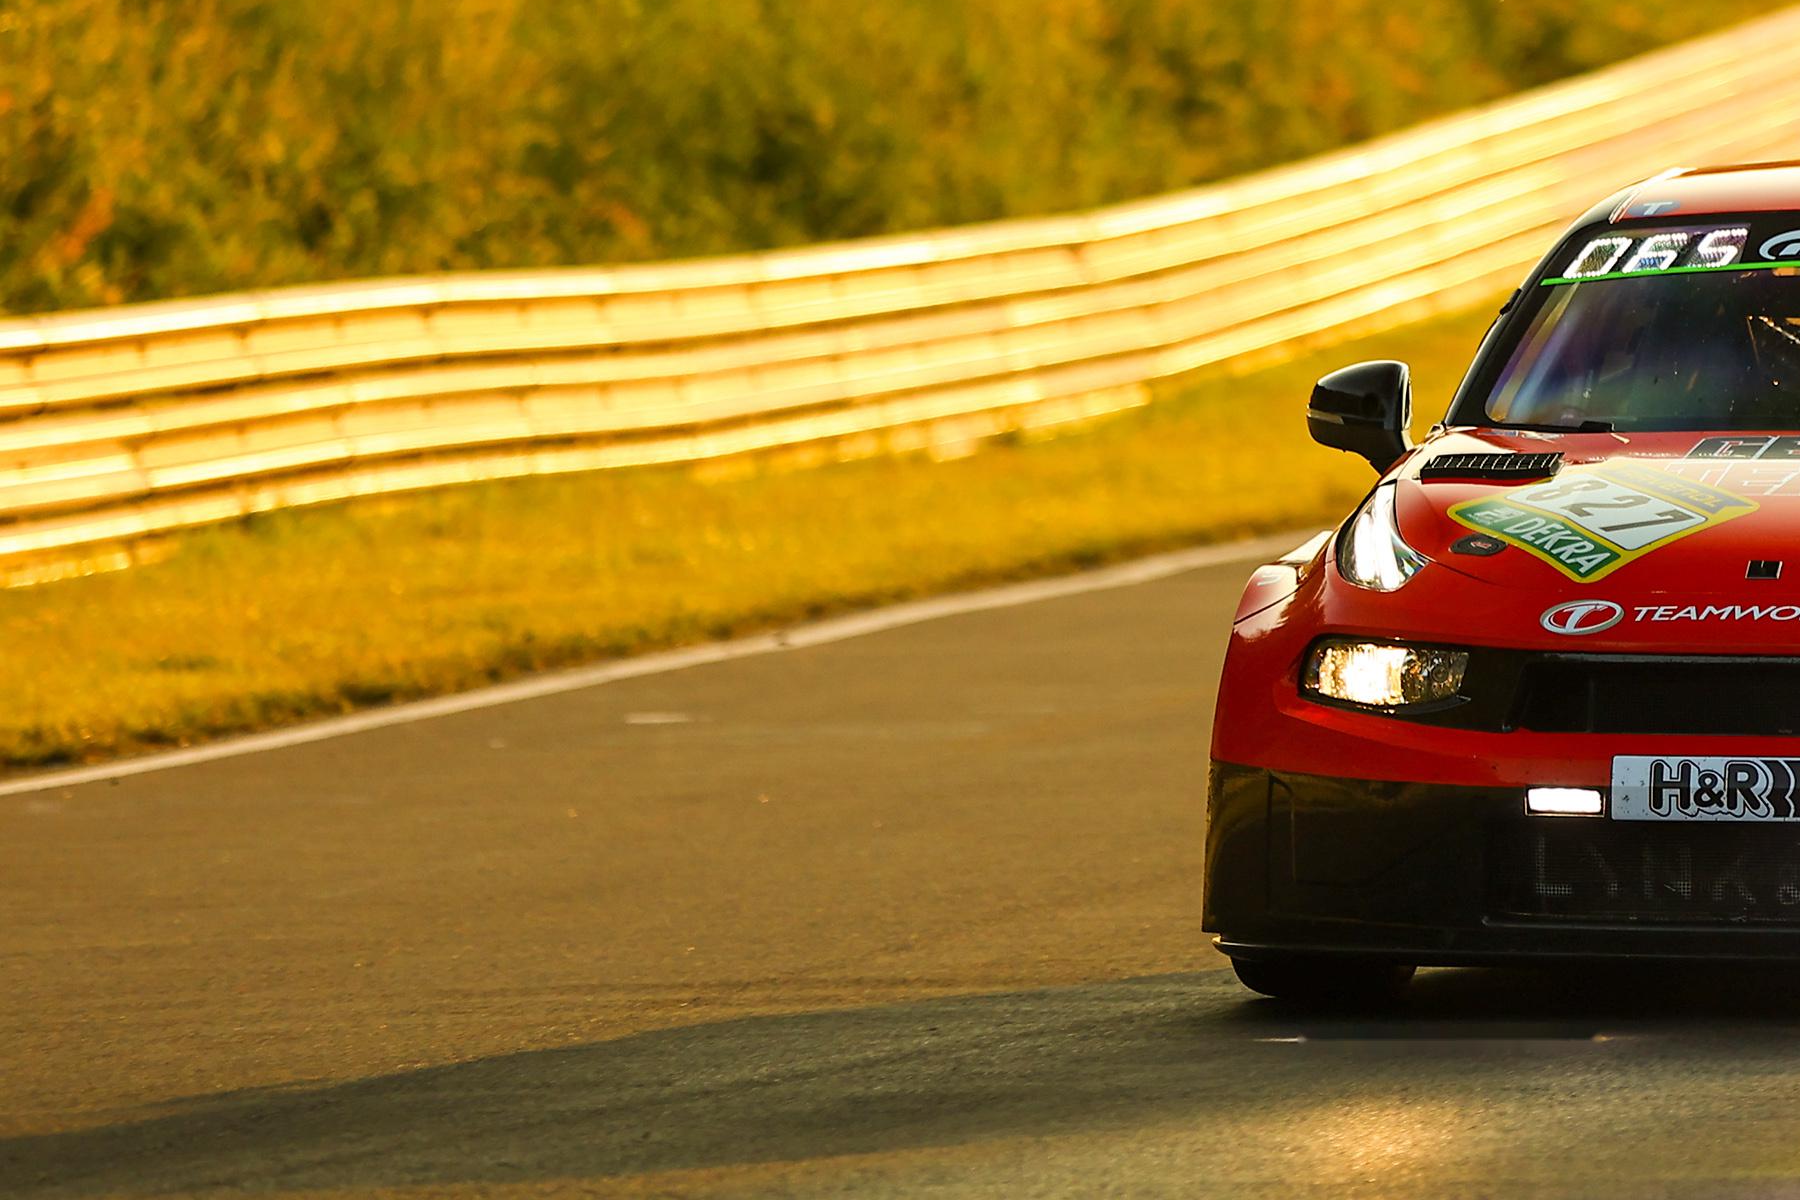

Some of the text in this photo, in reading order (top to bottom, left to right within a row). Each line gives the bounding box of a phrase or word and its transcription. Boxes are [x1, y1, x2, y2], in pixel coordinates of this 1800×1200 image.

[1526, 479, 1696, 533] 827
[1503, 516, 1611, 574] DEKRA
[1650, 759, 1770, 818] H&R
